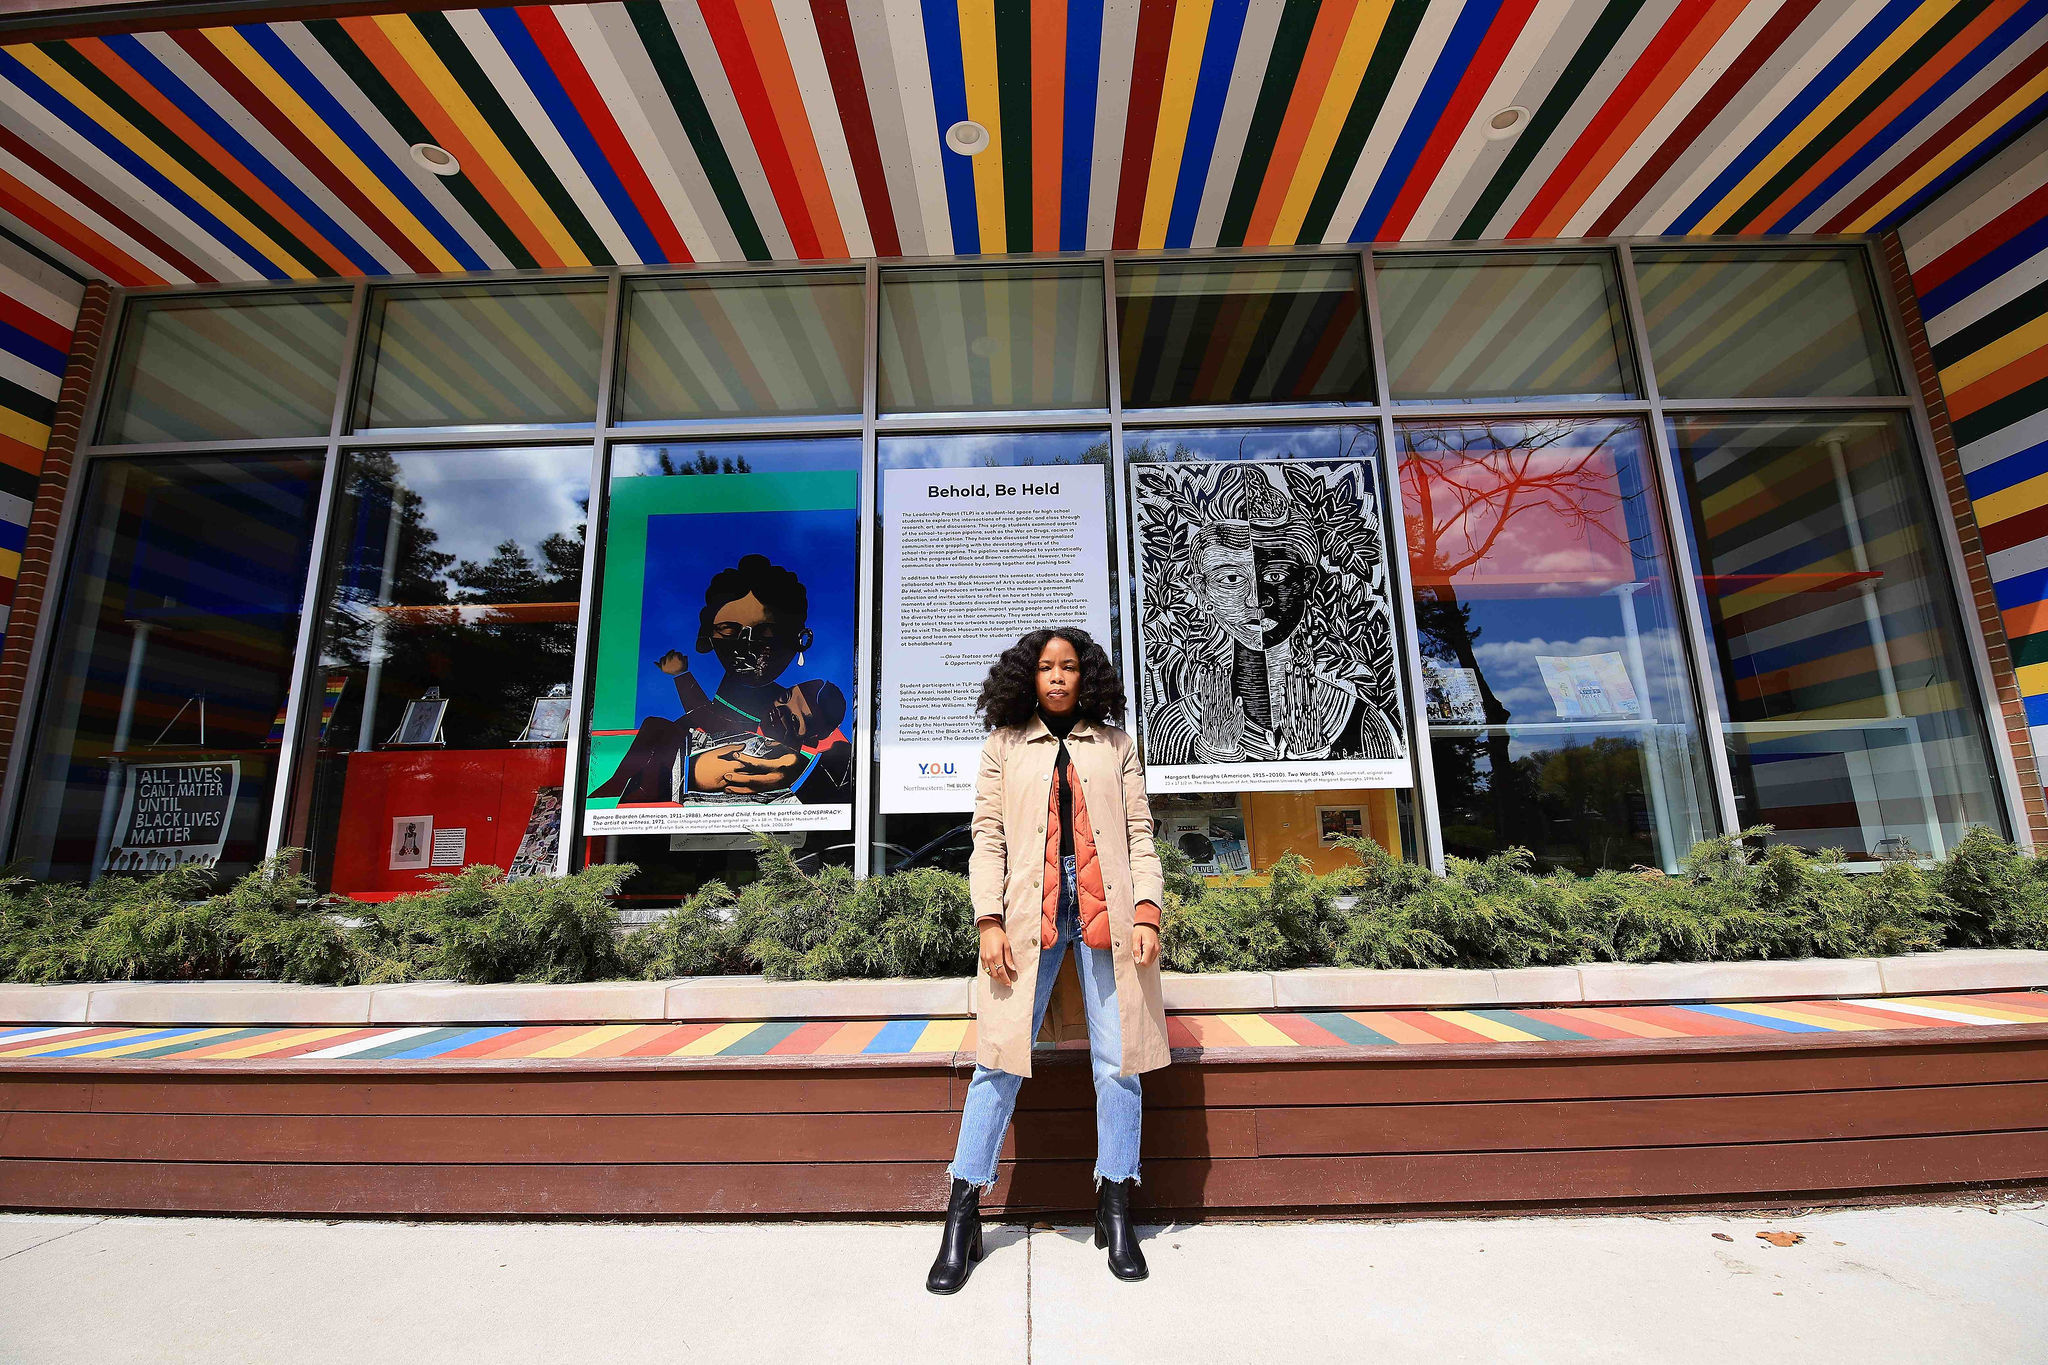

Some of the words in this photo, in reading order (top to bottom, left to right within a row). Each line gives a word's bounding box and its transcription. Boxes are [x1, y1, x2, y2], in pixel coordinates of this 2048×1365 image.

[928, 485, 990, 499] Behold,
[995, 484, 1017, 497] Be
[1022, 482, 1060, 496] Held
[140, 770, 170, 784] ALL
[179, 767, 222, 784] LIVES
[918, 762, 957, 775] Y.O.U.
[177, 783, 223, 797] MATTER
[138, 797, 182, 812] UNTIL
[135, 812, 181, 828] BLACK
[184, 811, 221, 827] LIVES
[130, 827, 190, 845] MATTER
